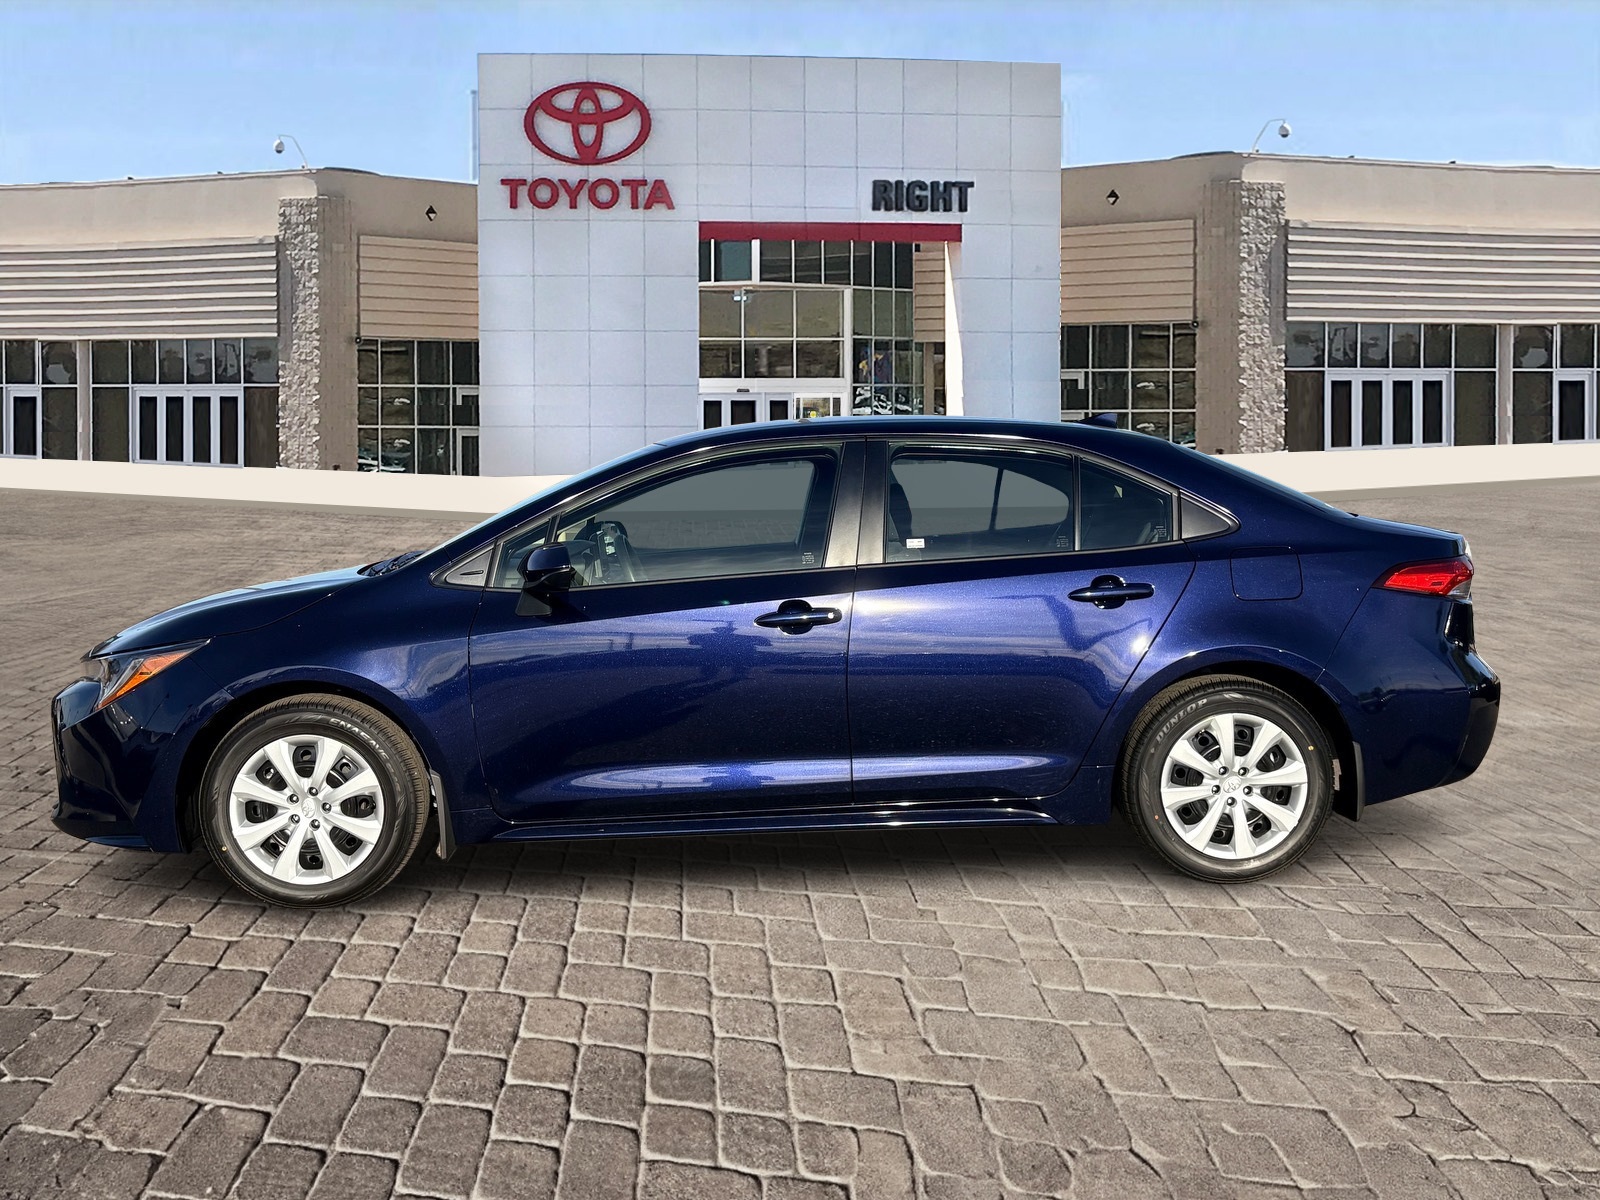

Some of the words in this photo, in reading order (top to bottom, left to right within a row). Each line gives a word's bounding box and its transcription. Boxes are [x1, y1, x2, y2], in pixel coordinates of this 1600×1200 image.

[500, 178, 675, 210] TOYOTA
[872, 179, 975, 212] RIGHT
[1156, 698, 1207, 743] DUNLOP
